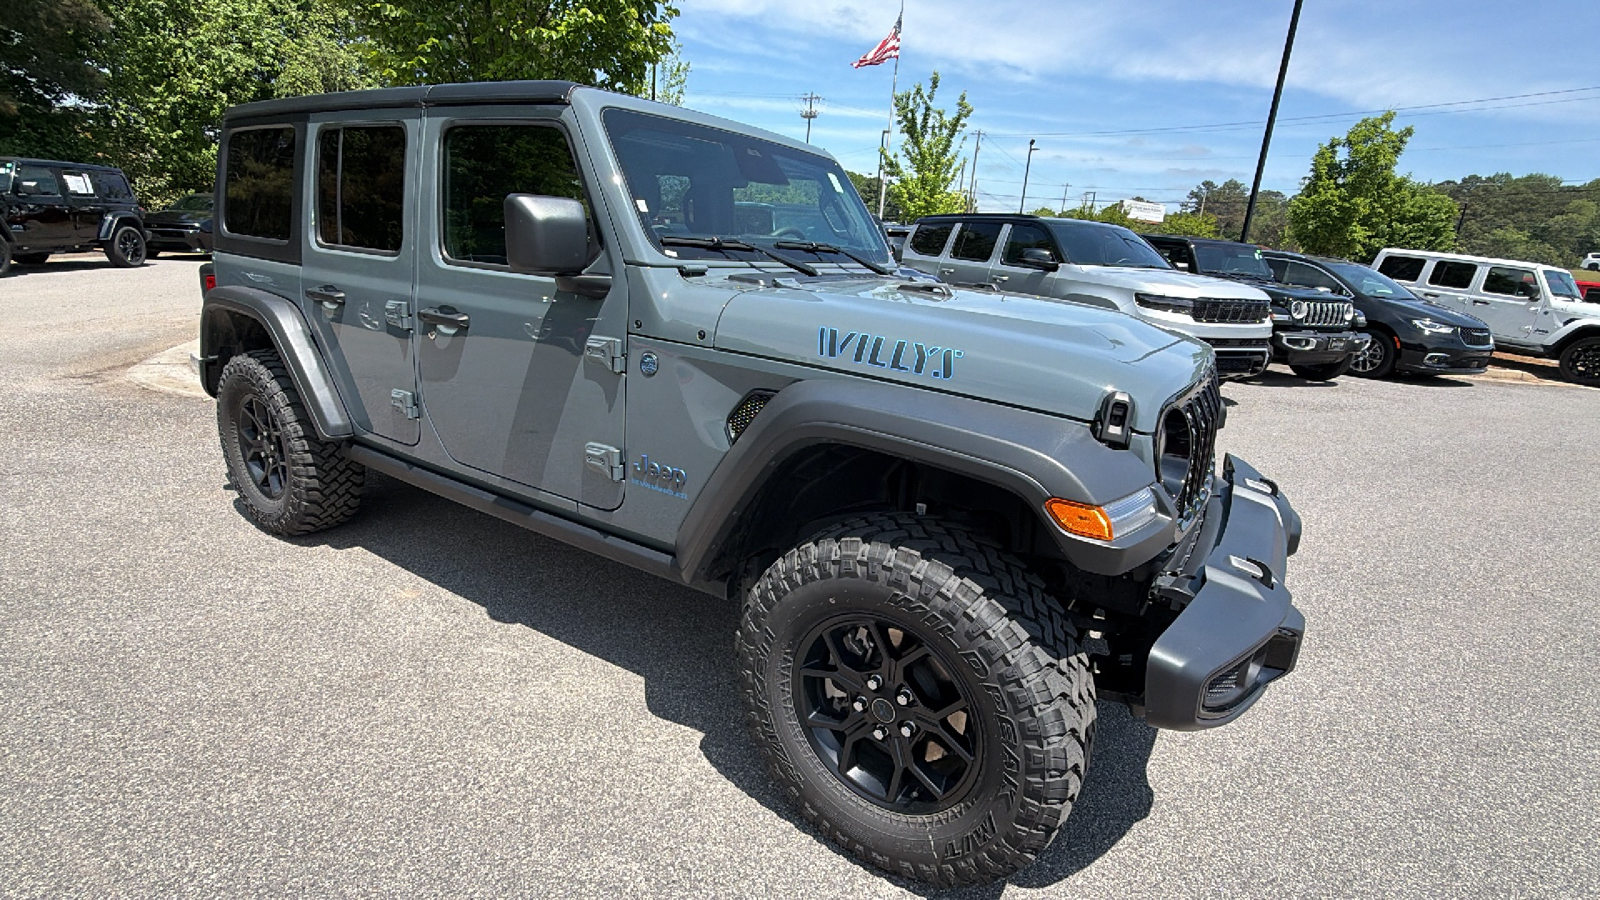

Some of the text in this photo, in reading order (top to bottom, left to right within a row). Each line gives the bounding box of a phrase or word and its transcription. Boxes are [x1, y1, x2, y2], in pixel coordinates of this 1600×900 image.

[818, 326, 964, 380] WILLYS
[633, 454, 687, 490] Jeep
[944, 811, 998, 860] M/T
